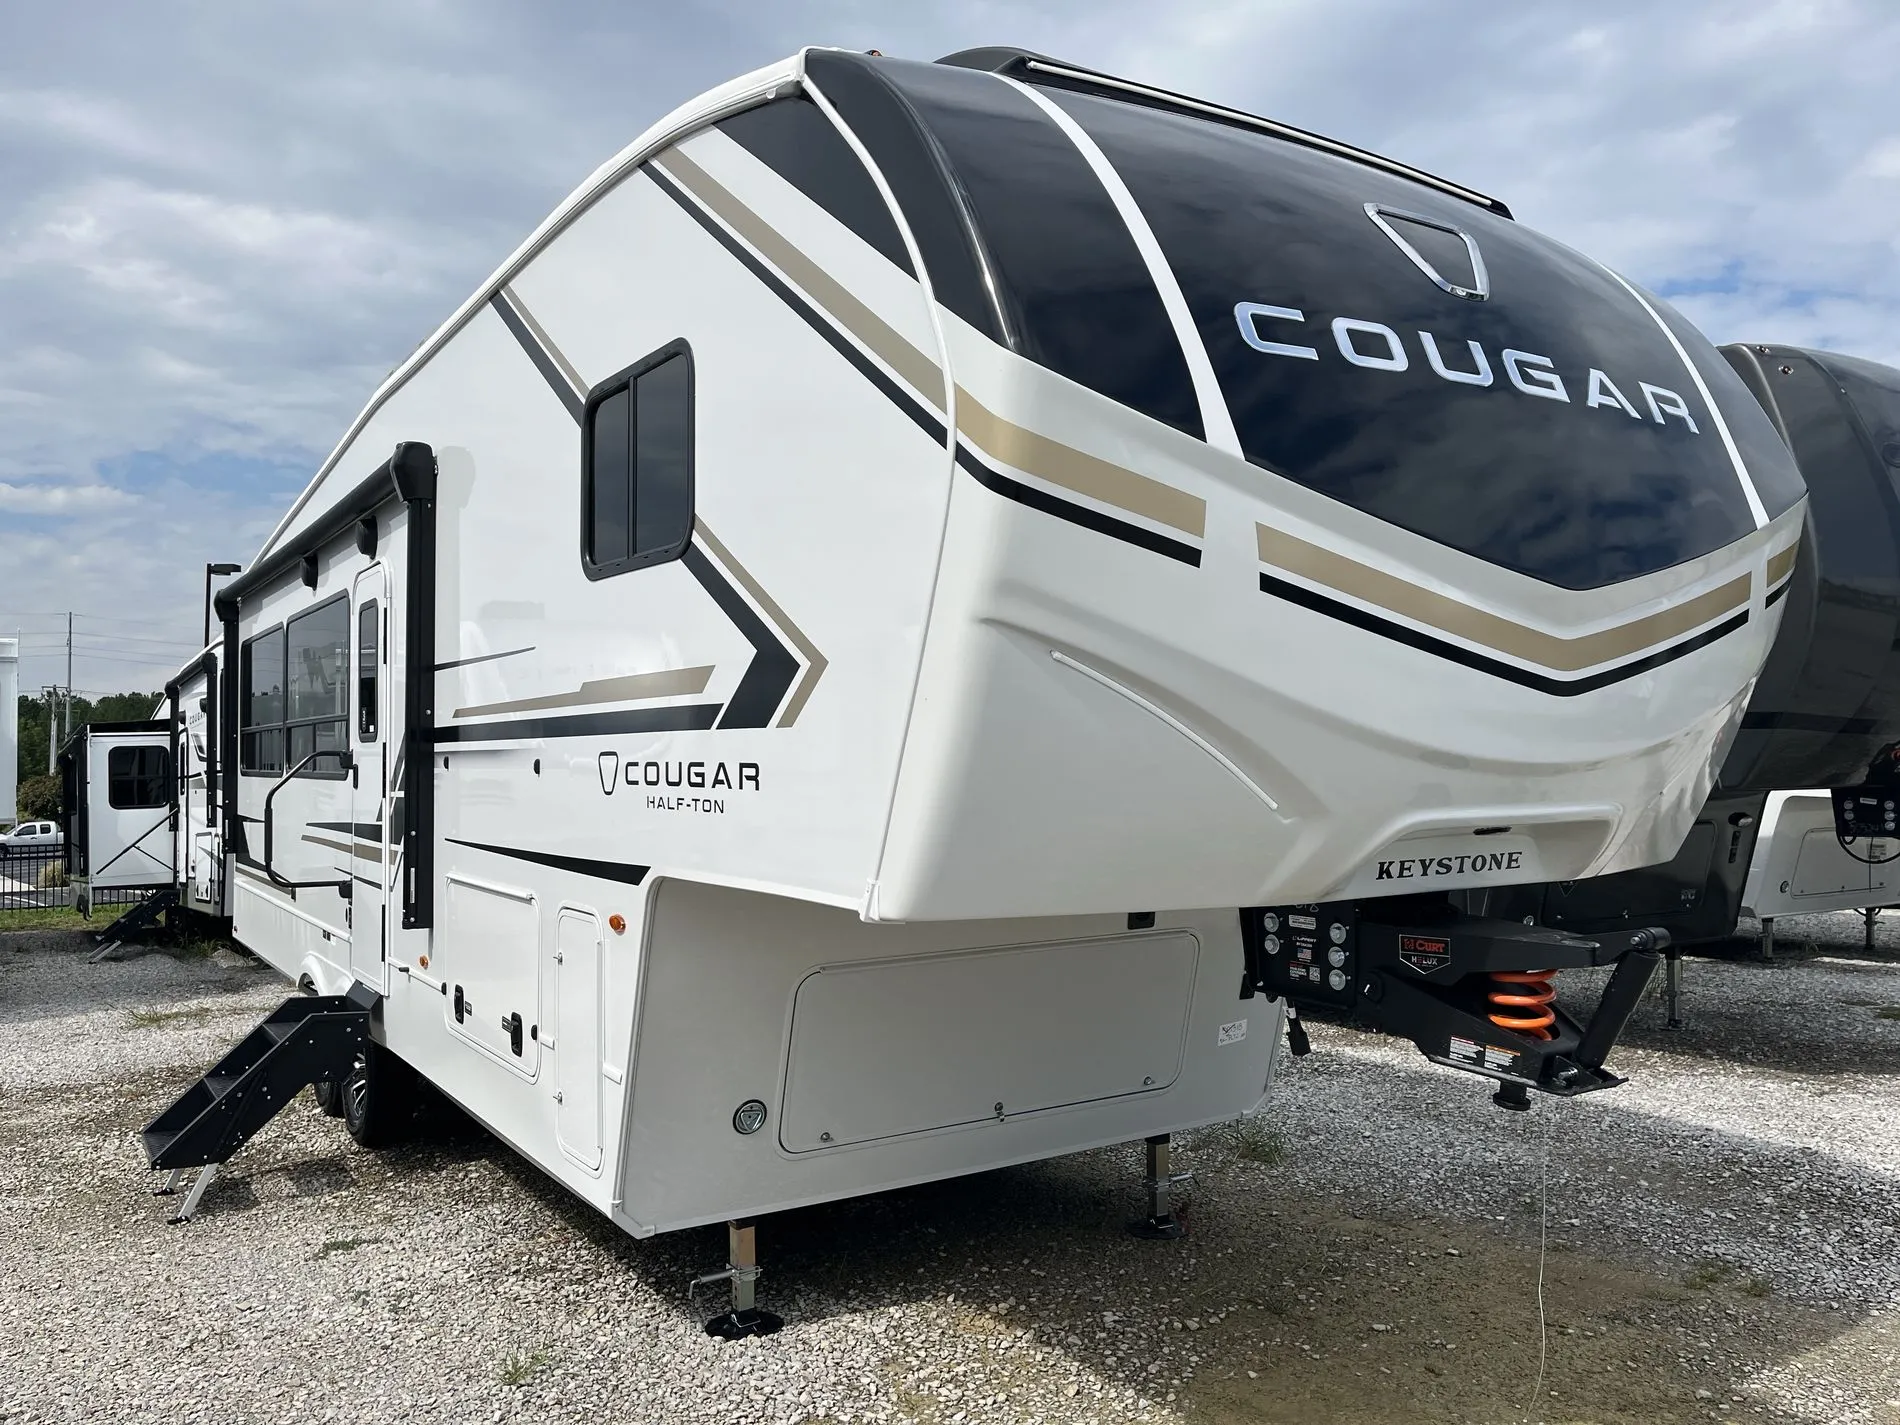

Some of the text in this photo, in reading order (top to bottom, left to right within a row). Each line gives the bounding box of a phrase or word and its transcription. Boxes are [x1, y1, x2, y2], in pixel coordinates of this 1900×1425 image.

[1234, 302, 1699, 434] COUGAR
[625, 761, 760, 791] COUGAR
[646, 795, 724, 814] HALF-TON
[1375, 851, 1523, 880] KEYSTONE
[1411, 955, 1438, 966] HELUX
